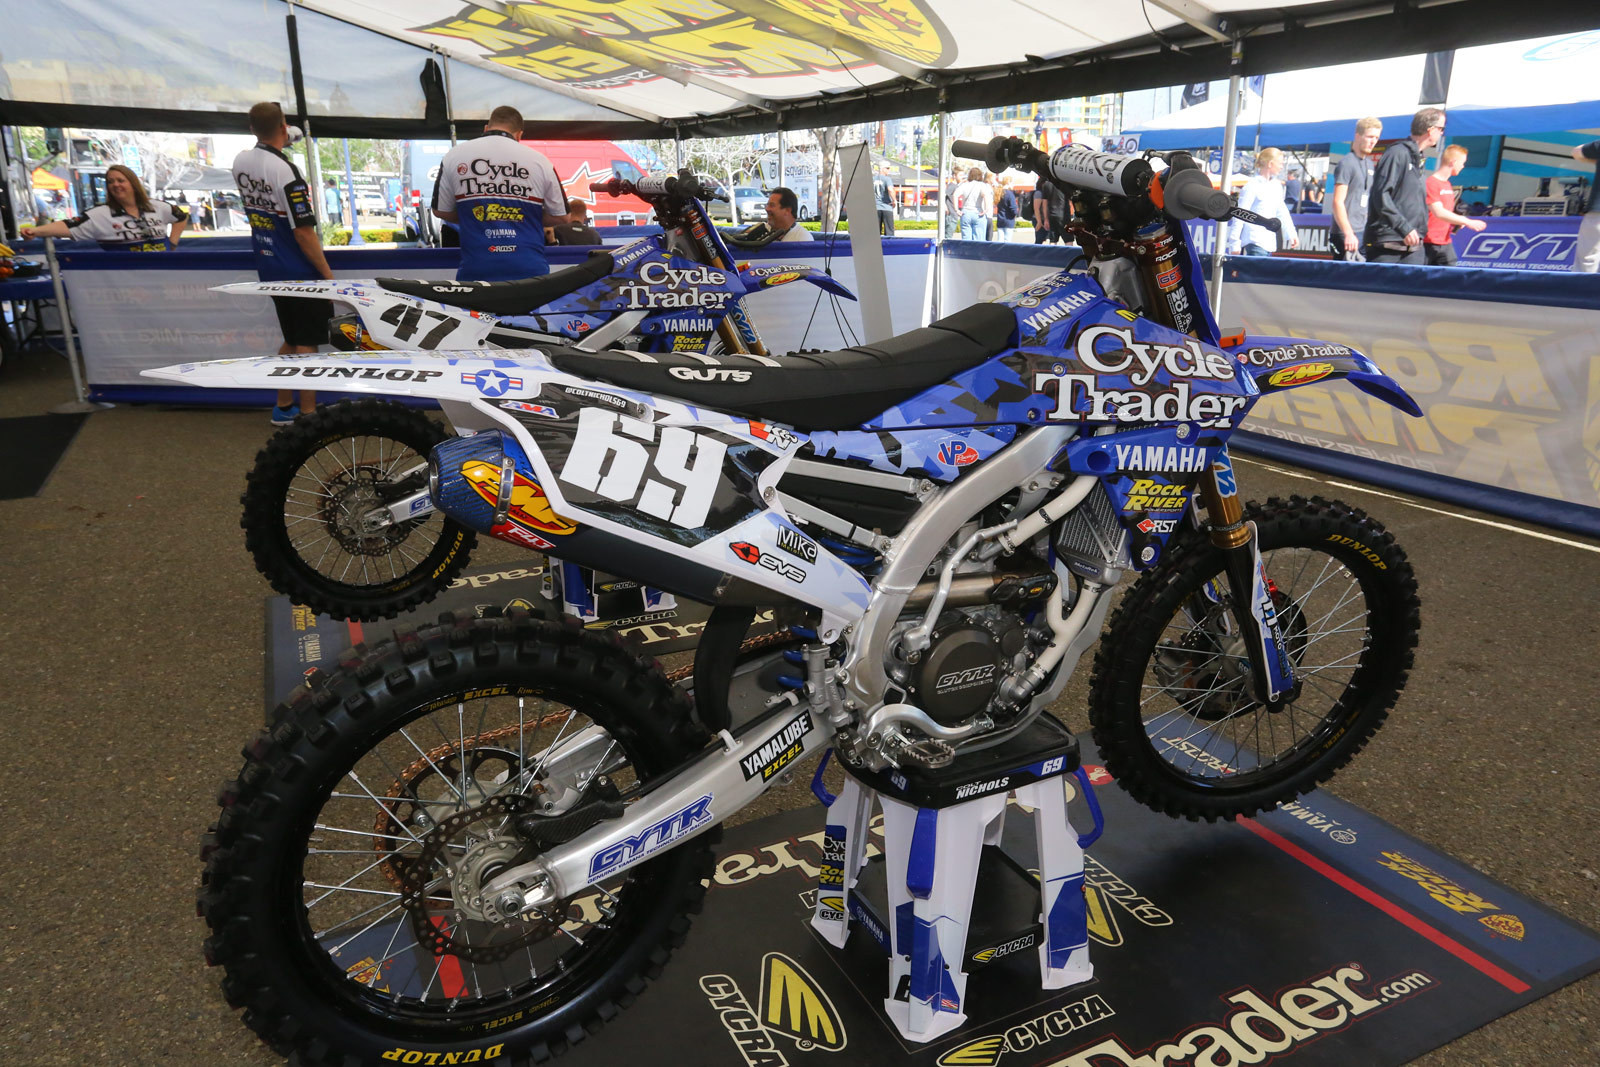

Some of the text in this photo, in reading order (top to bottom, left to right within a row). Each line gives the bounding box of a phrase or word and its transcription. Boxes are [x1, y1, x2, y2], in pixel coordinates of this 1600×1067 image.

[471, 158, 530, 181] Cycle
[460, 177, 533, 198] Trader
[484, 212, 525, 222] RIVER
[486, 203, 522, 214] ROCK
[1230, 208, 1258, 223] ARC
[492, 229, 517, 237] YAMAHA
[616, 244, 655, 266] YAMAHA
[1461, 233, 1579, 261] GYT
[639, 262, 727, 290] Cycle
[755, 266, 781, 278] Cycle
[1492, 261, 1526, 270] YAMAHA
[257, 286, 331, 294] DUNLOP
[432, 285, 474, 293] GUTS
[619, 281, 735, 309] Trader
[1023, 290, 1097, 331] YAMAHA
[380, 302, 462, 351] 47
[567, 319, 583, 332] VP
[663, 319, 714, 332] YAMAHA
[672, 342, 706, 352] RIVER
[673, 335, 704, 344] ROCK
[1076, 324, 1237, 386] Cycle
[1249, 343, 1350, 368] Cycle Trader
[267, 366, 444, 382] DUNLOP
[669, 367, 752, 382] GUTS
[1270, 363, 1334, 385] FMF
[503, 402, 558, 417] AMA
[1035, 372, 1249, 429] Trader
[770, 427, 798, 450] K&N
[939, 440, 967, 466] VP
[1116, 445, 1206, 472] YAMAHA
[559, 407, 728, 530] 69
[1128, 479, 1186, 496] ROCK
[1123, 495, 1187, 511] RIVER
[778, 525, 817, 560] Mika
[1327, 534, 1388, 570] DUNLOP
[432, 531, 463, 579] DUNLOP
[615, 611, 678, 627] CYCRA
[936, 664, 996, 689] GYTR
[464, 687, 510, 700] EXCEL
[743, 715, 809, 776] YAMALUBE
[764, 744, 802, 778] EXCEL
[1041, 756, 1064, 776] 69
[956, 777, 1010, 800] NICHOLS
[1276, 801, 1335, 832] YAMA
[588, 795, 714, 878] GYTR
[587, 816, 713, 884] GENUINE YAMAHA TECHNOLOGY RACING
[821, 909, 844, 920] CYC
[994, 934, 1035, 958] CYCRA
[699, 974, 789, 1067] CYCRA
[1004, 993, 1117, 1056] CYCRA
[381, 1043, 505, 1066] DUNLOP
